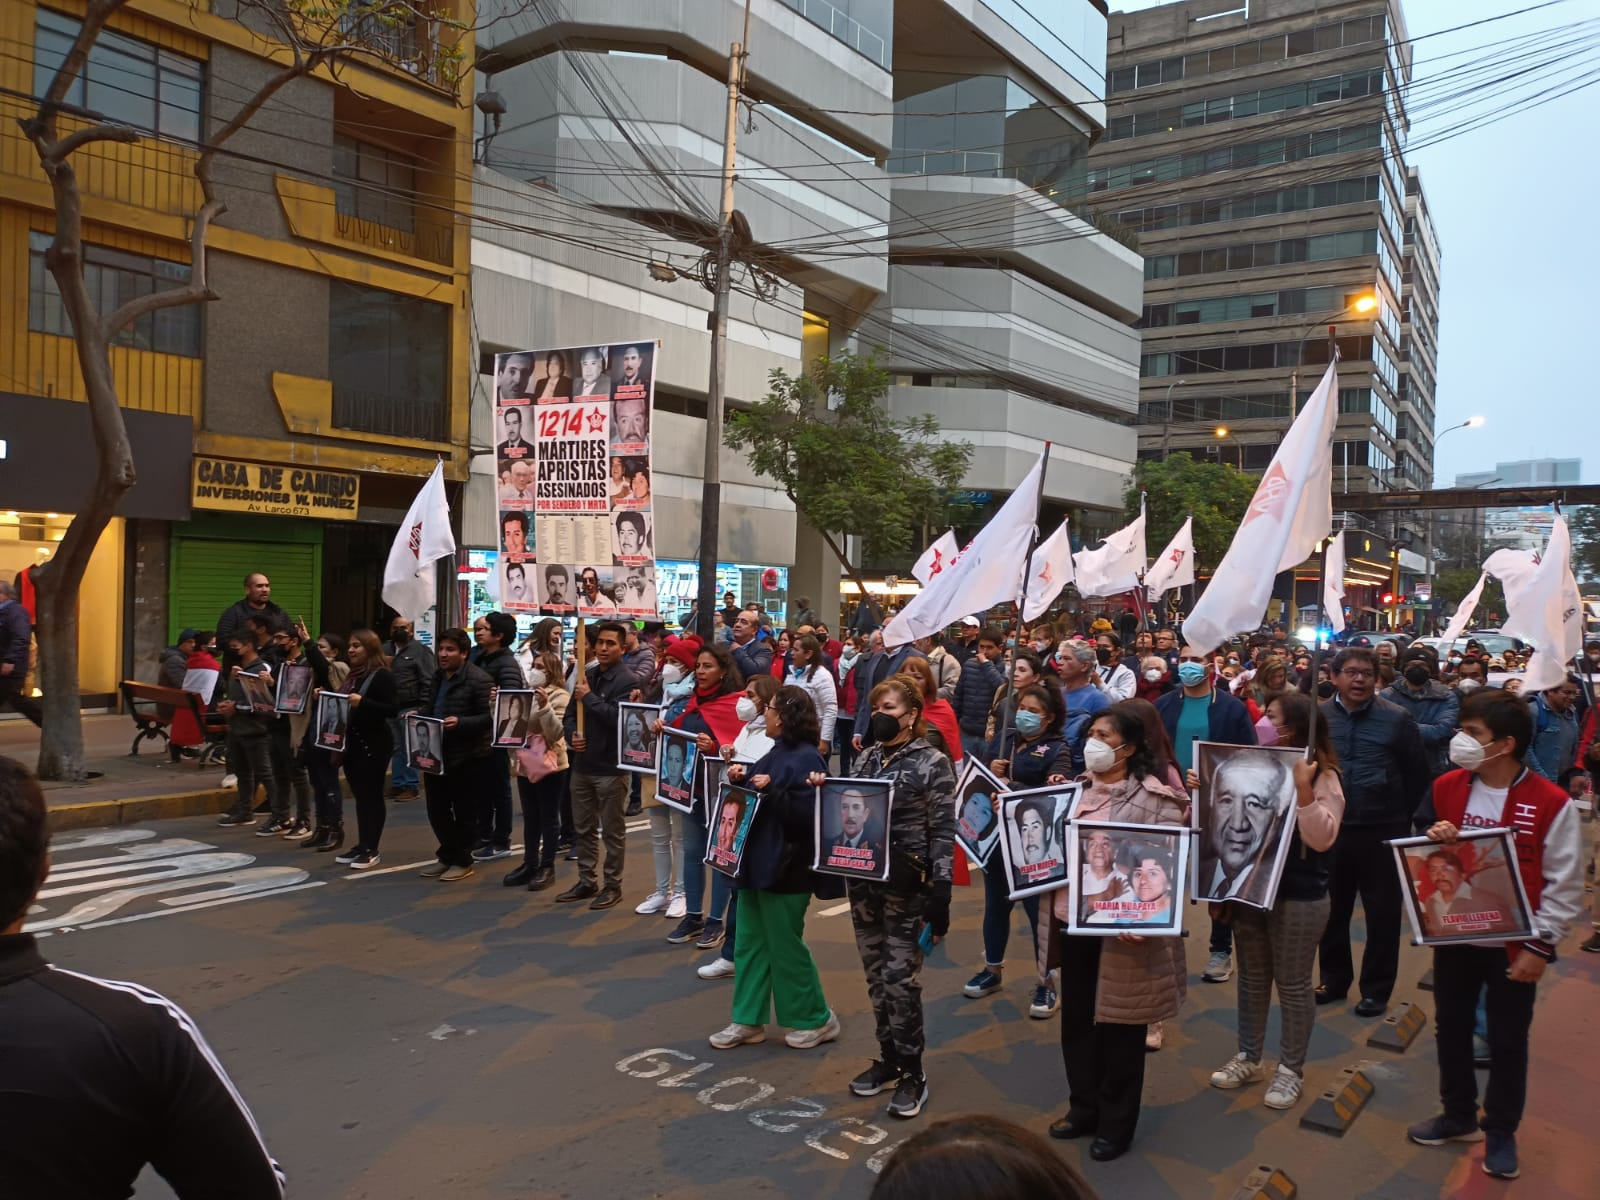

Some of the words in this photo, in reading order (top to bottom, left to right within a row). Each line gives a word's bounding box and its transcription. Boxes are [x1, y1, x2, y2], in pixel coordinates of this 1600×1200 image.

[538, 407, 584, 437] 1214
[538, 437, 606, 460] MÁRTIRES
[198, 460, 249, 487] CASA
[260, 467, 283, 490] DE
[290, 470, 357, 497] CAMBIO
[537, 460, 606, 481] APRISTAS
[197, 485, 290, 504] INVERSIONES
[536, 482, 607, 498] ASESINADOS
[265, 505, 292, 514] Larco
[293, 506, 310, 515] 673
[537, 500, 550, 510] POR
[552, 500, 581, 510] SENDERO
[582, 500, 587, 510] Y
[588, 500, 607, 510] MRTA
